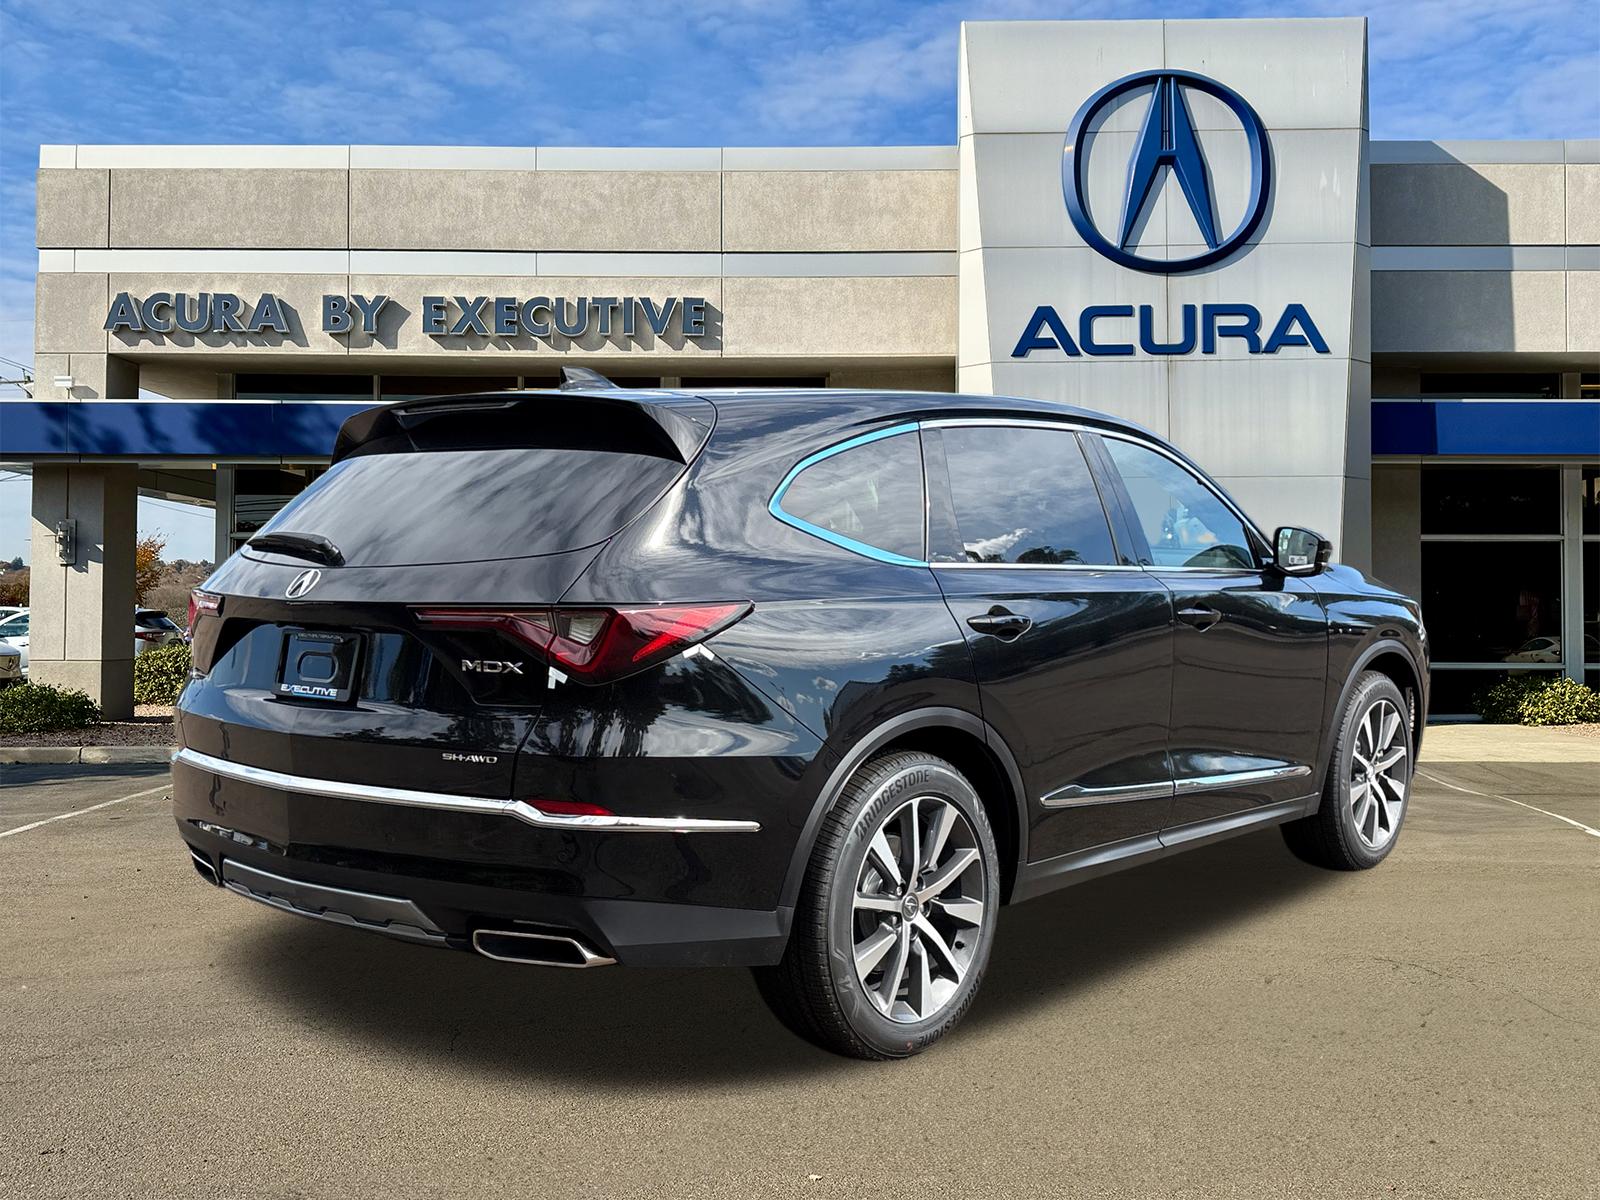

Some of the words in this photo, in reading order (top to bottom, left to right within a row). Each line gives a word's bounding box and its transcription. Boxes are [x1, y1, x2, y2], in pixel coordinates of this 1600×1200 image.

[104, 291, 290, 334] ACURA
[321, 294, 391, 335] BY
[421, 296, 707, 337] EXECUTIVE
[1010, 303, 1332, 357] ACURA
[461, 659, 524, 675] MDX
[280, 683, 339, 697] EXECUTIVE
[441, 752, 498, 764] SH-AWD
[854, 769, 930, 841] BRIDGESTONE
